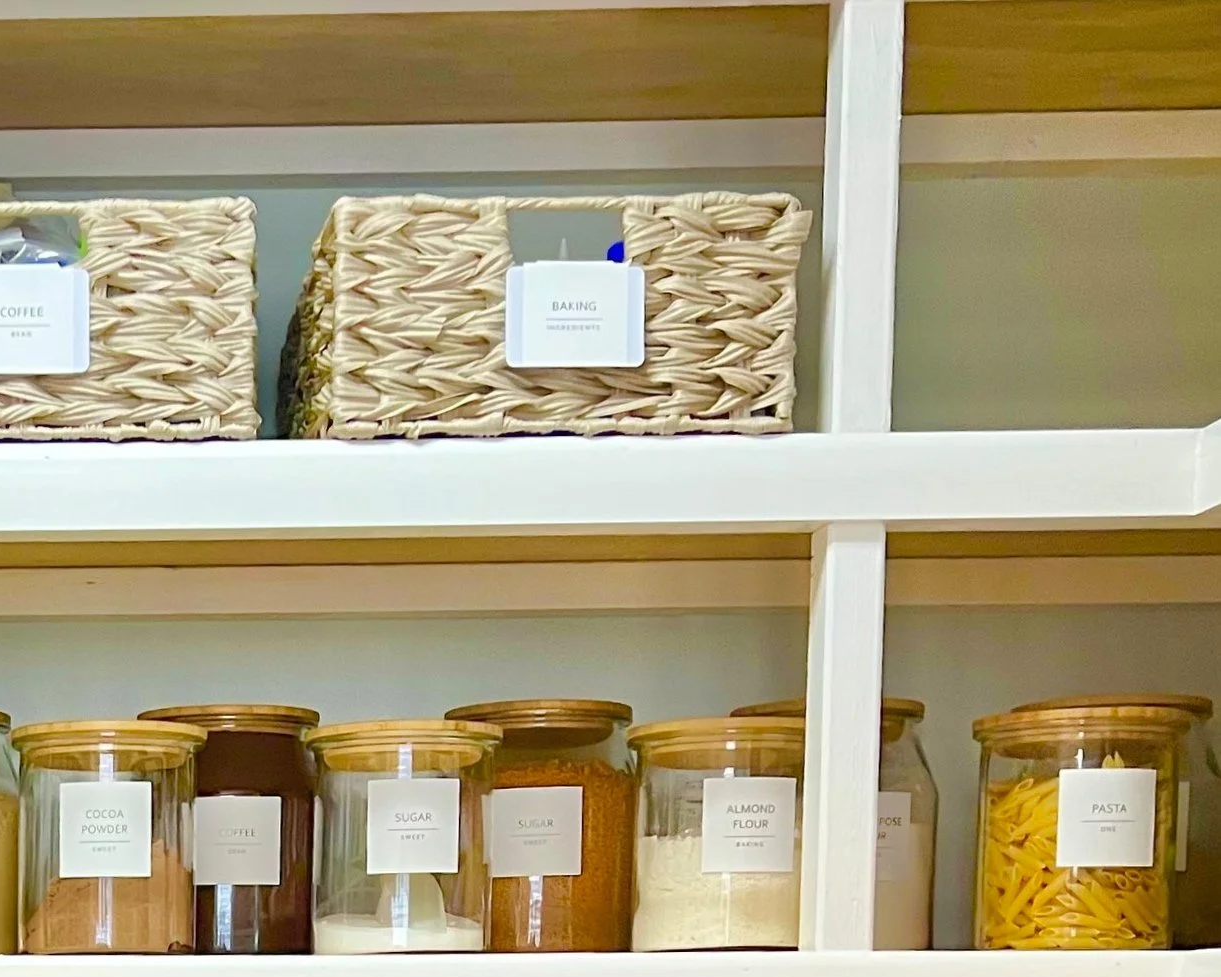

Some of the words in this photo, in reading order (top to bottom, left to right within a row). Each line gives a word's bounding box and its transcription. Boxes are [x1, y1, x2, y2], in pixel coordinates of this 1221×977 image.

[0, 306, 44, 318] COFFEE
[551, 302, 597, 312] BAKING
[84, 808, 125, 820] COCOA
[726, 803, 776, 815] ALMOND
[1091, 803, 1128, 814] PASTA
[394, 812, 432, 823] SUGAR
[879, 816, 903, 828] POSE
[80, 823, 128, 835] POWDER
[517, 818, 554, 830] SUGAR
[732, 819, 769, 831] FLOUR
[218, 827, 257, 839] COFFEE
[400, 833, 426, 841] SWEET
